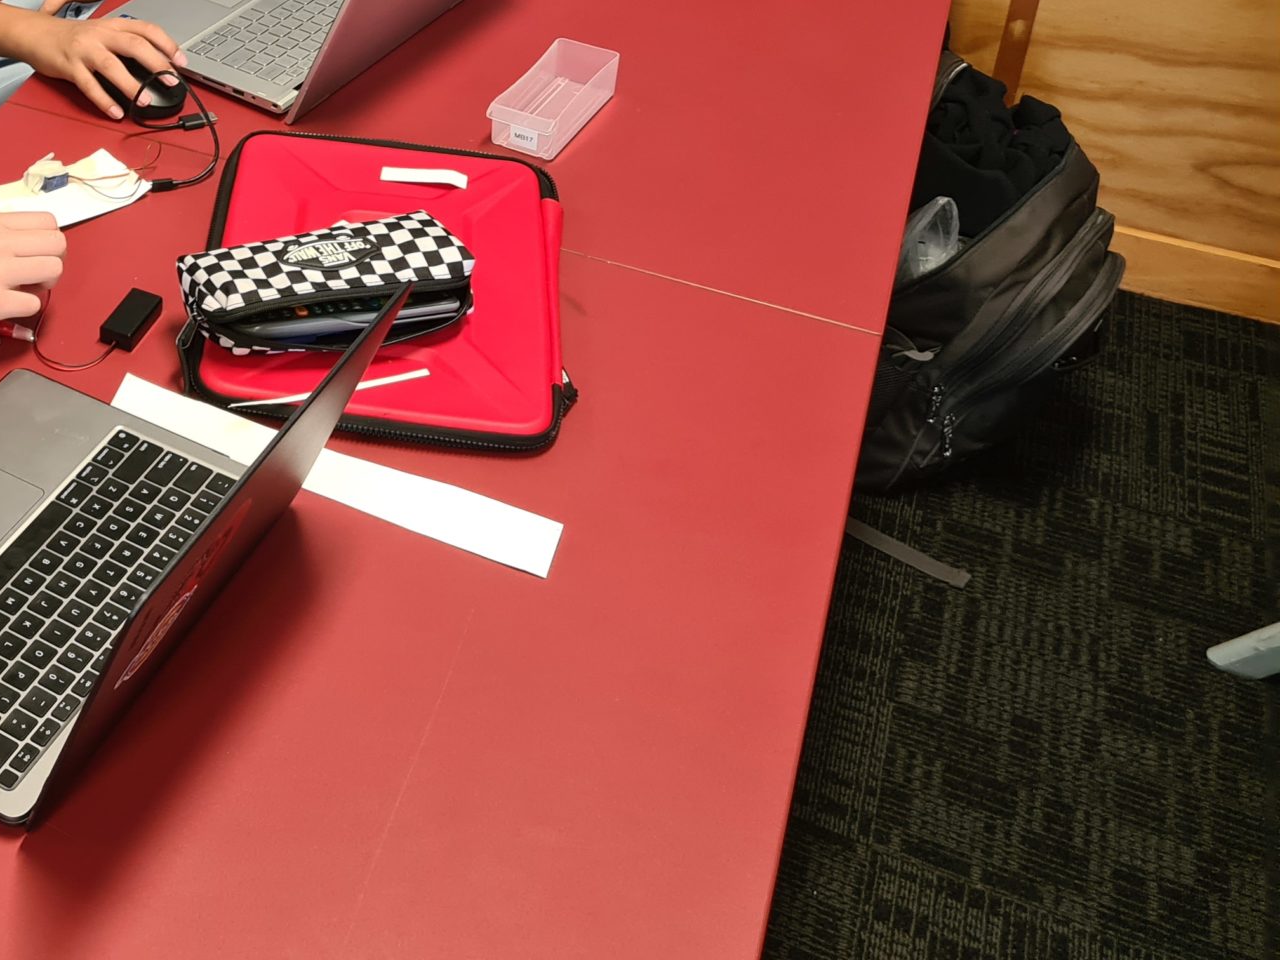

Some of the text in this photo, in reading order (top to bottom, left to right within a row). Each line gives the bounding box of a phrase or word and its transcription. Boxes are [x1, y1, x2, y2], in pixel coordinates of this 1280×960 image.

[514, 132, 534, 142] MB17
[315, 242, 347, 256] THE
[319, 251, 356, 267] VANS
[154, 513, 164, 521] W
[24, 577, 33, 585] N
[58, 580, 68, 588] H
[5, 597, 16, 605] M
[22, 620, 32, 628] K
[67, 651, 76, 659] 9
[18, 671, 26, 679] P
